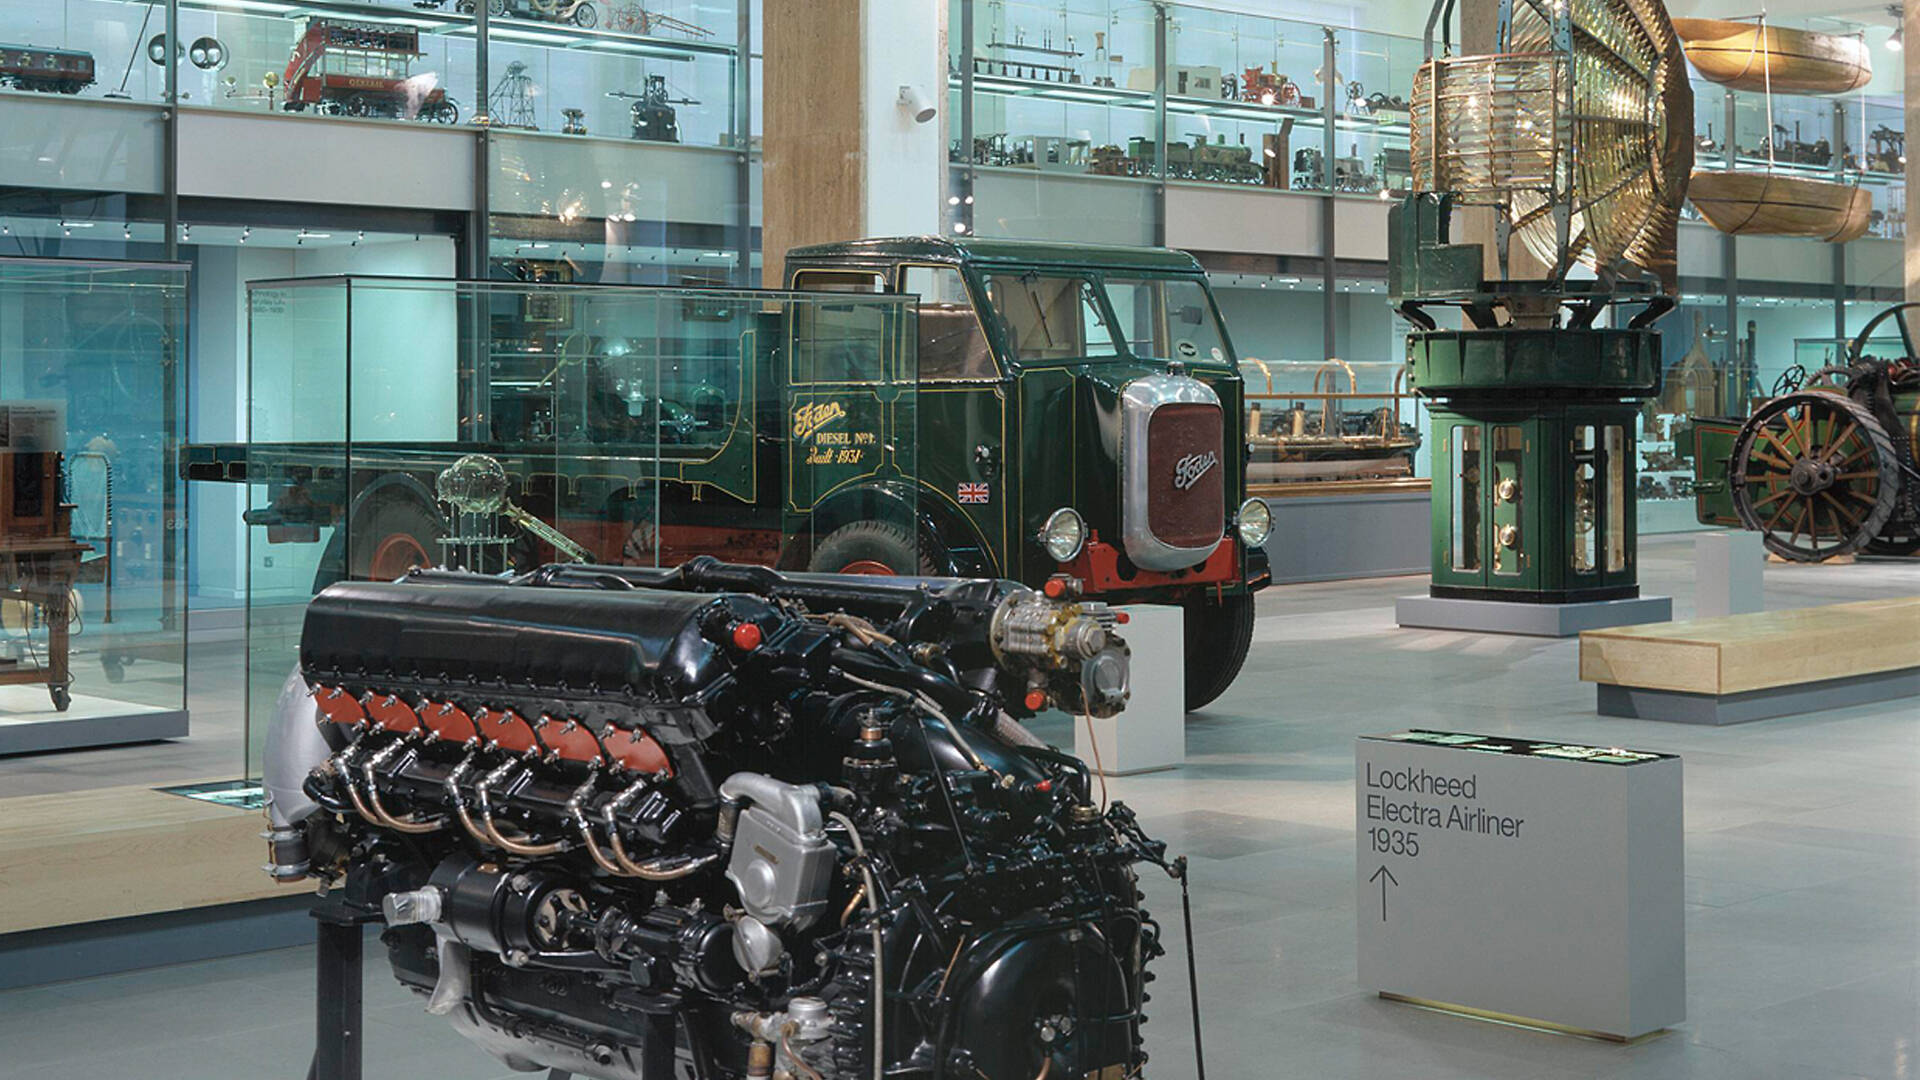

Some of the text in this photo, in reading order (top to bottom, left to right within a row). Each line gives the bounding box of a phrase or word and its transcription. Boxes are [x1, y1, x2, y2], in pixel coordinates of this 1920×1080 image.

[806, 446, 834, 464] Built
[816, 432, 851, 445] DIESEL
[1174, 451, 1218, 490] Foden
[1366, 762, 1477, 799] Lockheed
[1367, 794, 1524, 838] Electra Airliner
[1368, 826, 1420, 857] 1935
